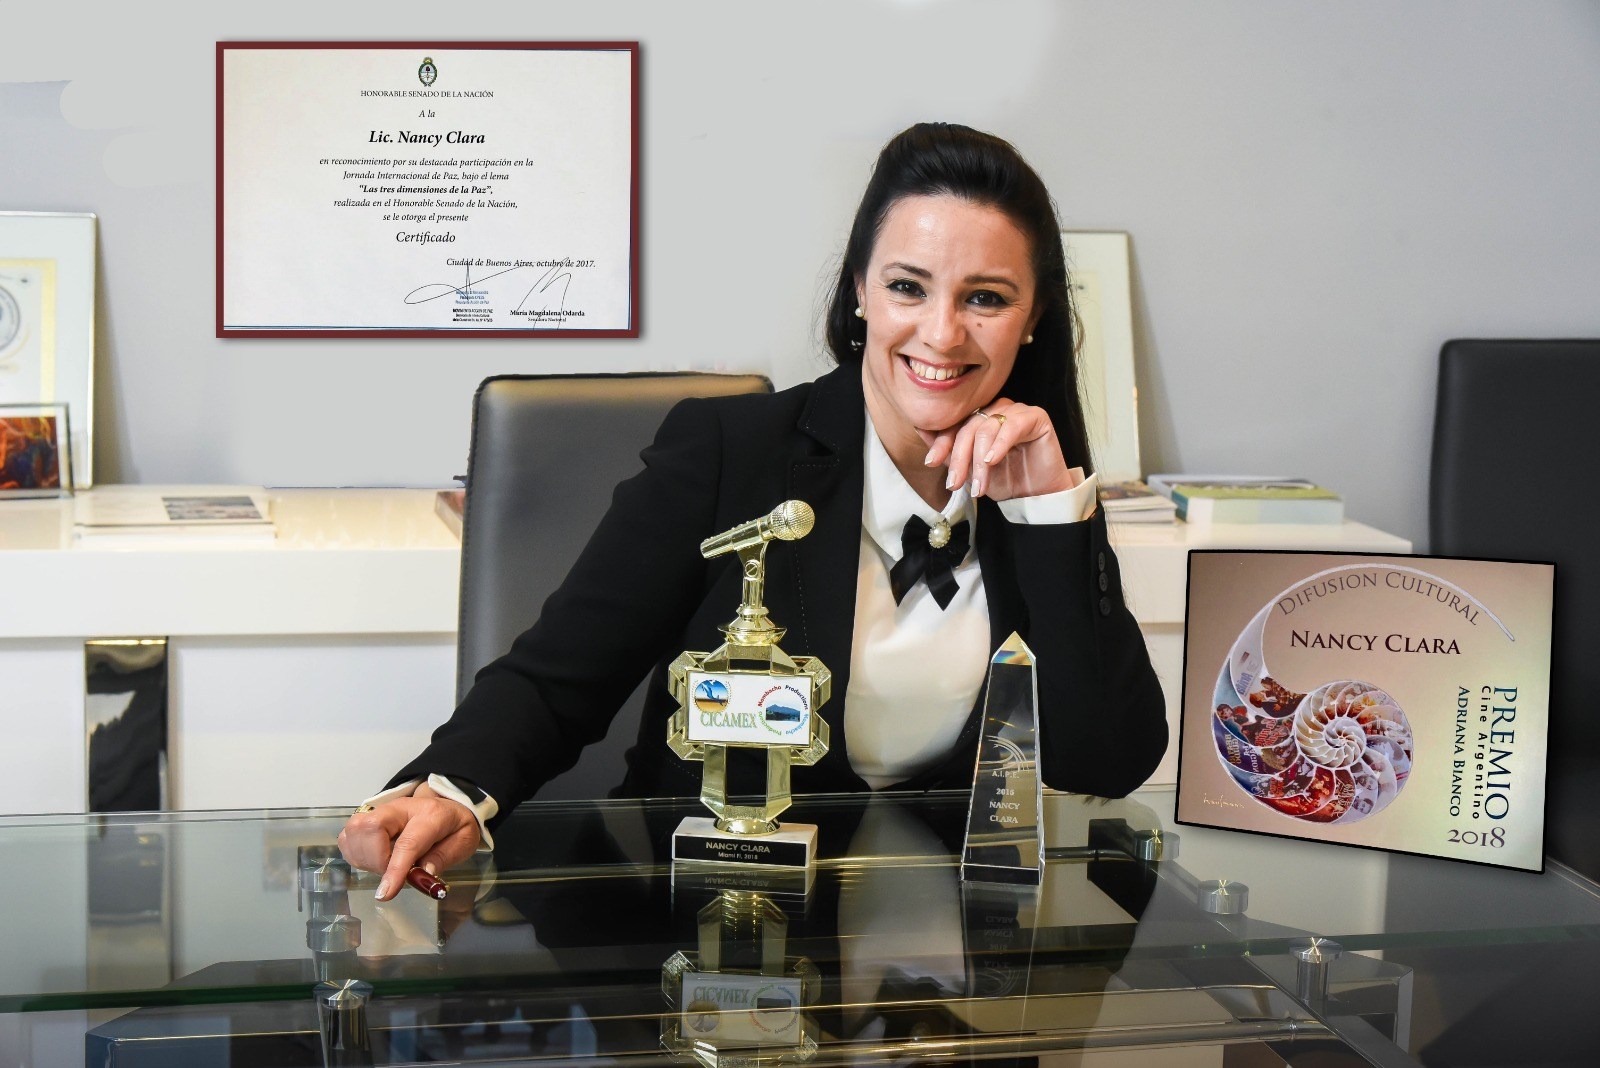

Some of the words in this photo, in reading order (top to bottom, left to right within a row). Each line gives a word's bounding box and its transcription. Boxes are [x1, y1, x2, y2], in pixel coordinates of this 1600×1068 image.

[418, 110, 426, 118] A
[368, 131, 393, 143] Lic.
[398, 131, 442, 147] Nancy
[446, 131, 485, 144] Clara
[392, 160, 406, 168] por
[420, 158, 457, 166] destacada
[459, 158, 512, 168] participación
[526, 158, 533, 166] la
[343, 171, 374, 180] Jornada
[443, 172, 459, 180] Paz,
[462, 172, 479, 182] bajo
[481, 172, 488, 180] el
[490, 172, 509, 180] lema
[397, 185, 447, 193] dimensiones
[334, 198, 370, 206] realizada
[393, 199, 434, 207] Honorable
[436, 199, 464, 207] Senado
[487, 200, 517, 208] Nación,
[402, 214, 426, 223] otorga
[436, 214, 468, 223] presente
[396, 231, 455, 245] Certificado
[447, 258, 474, 267] Ciudad
[475, 258, 484, 266] de
[486, 259, 511, 267] Buenos
[513, 259, 535, 268] Aires,
[536, 259, 564, 268] octubre
[576, 260, 595, 268] 2017.
[529, 310, 561, 318] Magdalena
[1278, 573, 1377, 615] DIFUSION
[1386, 572, 1479, 625] CULTURAL
[1291, 630, 1377, 652] NANCY
[1385, 634, 1461, 655] CLARA
[757, 685, 782, 707] Mombacho
[785, 685, 808, 710] Productions
[1481, 685, 1492, 722] Cine
[700, 712, 758, 728] CICAMEX
[1452, 686, 1470, 757] ADRIANA
[1483, 686, 1518, 821] PREMIO
[1472, 732, 1489, 820] Argentino
[1447, 759, 1464, 818] BIANCO
[989, 802, 1020, 810] NANCY
[989, 815, 1018, 823] CLARA
[1448, 827, 1505, 848] 2018
[706, 842, 738, 850] NANCY
[740, 845, 770, 853] CLARA
